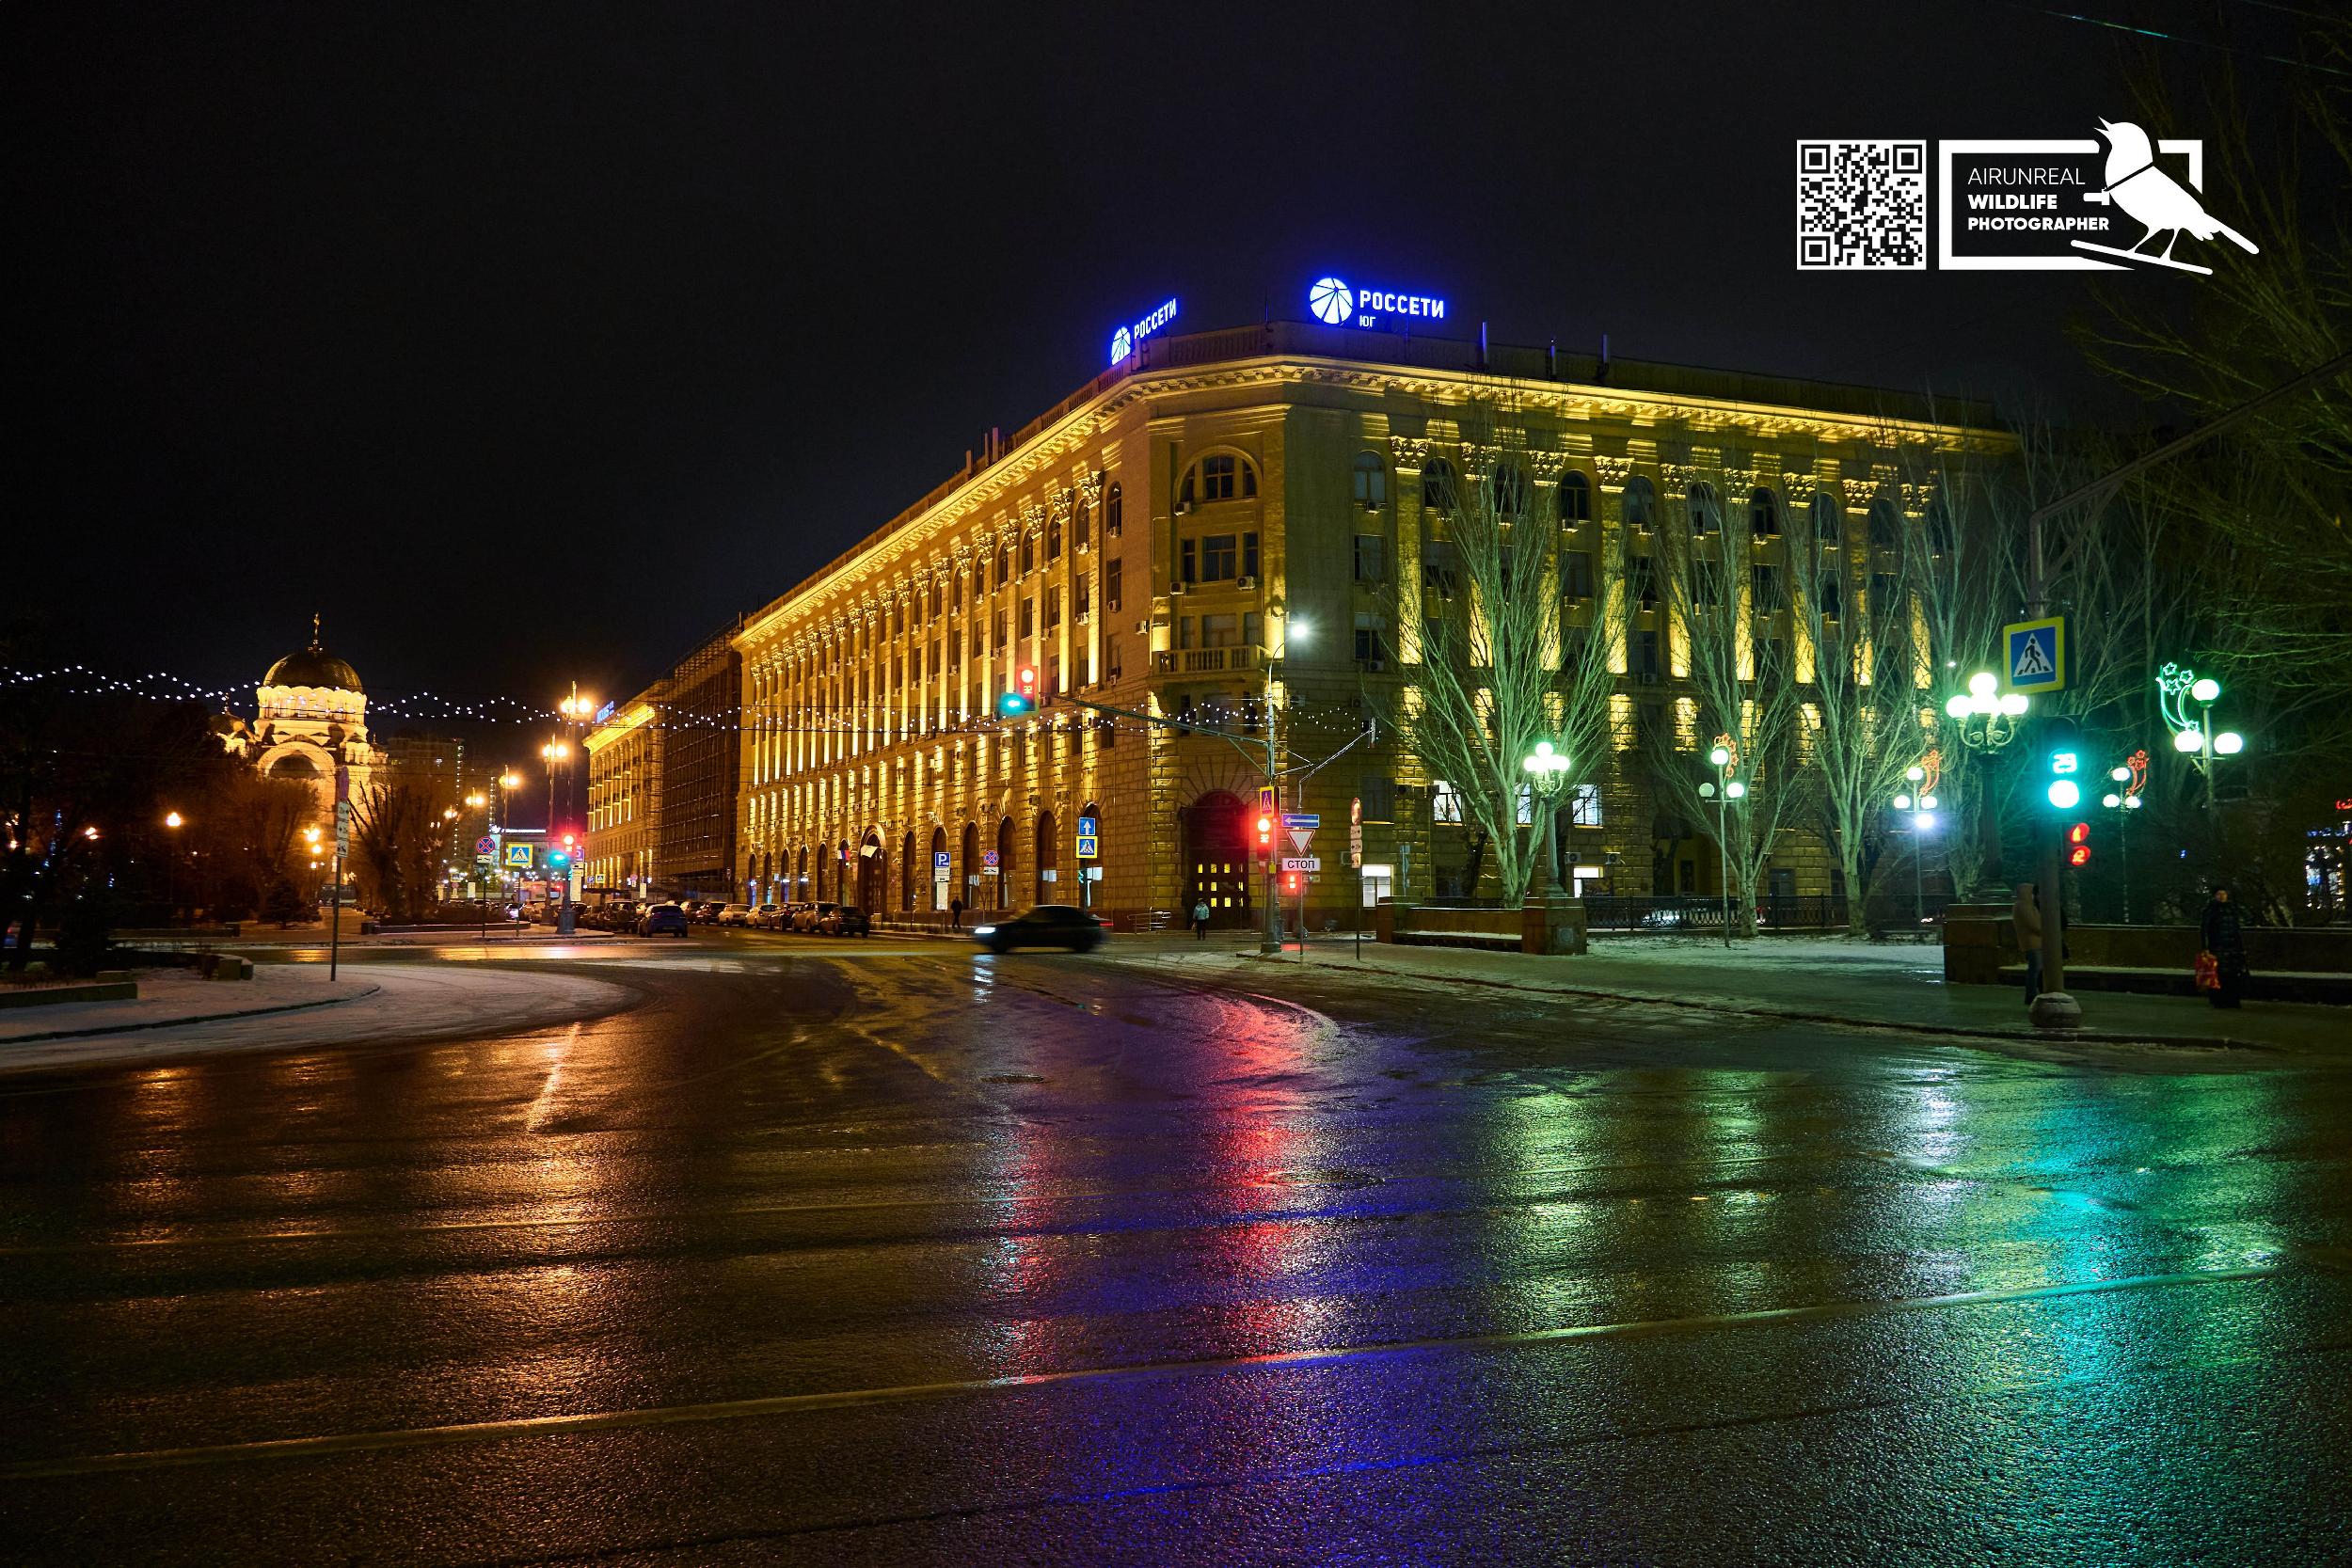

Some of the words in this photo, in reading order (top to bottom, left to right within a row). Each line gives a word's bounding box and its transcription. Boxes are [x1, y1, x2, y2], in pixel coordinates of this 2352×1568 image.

[1359, 290, 1444, 319] РОССЕТИ
[1134, 297, 1177, 340] РОССЕТИ
[1359, 314, 1376, 328] ЮГ
[1287, 860, 1315, 869] СТОП
